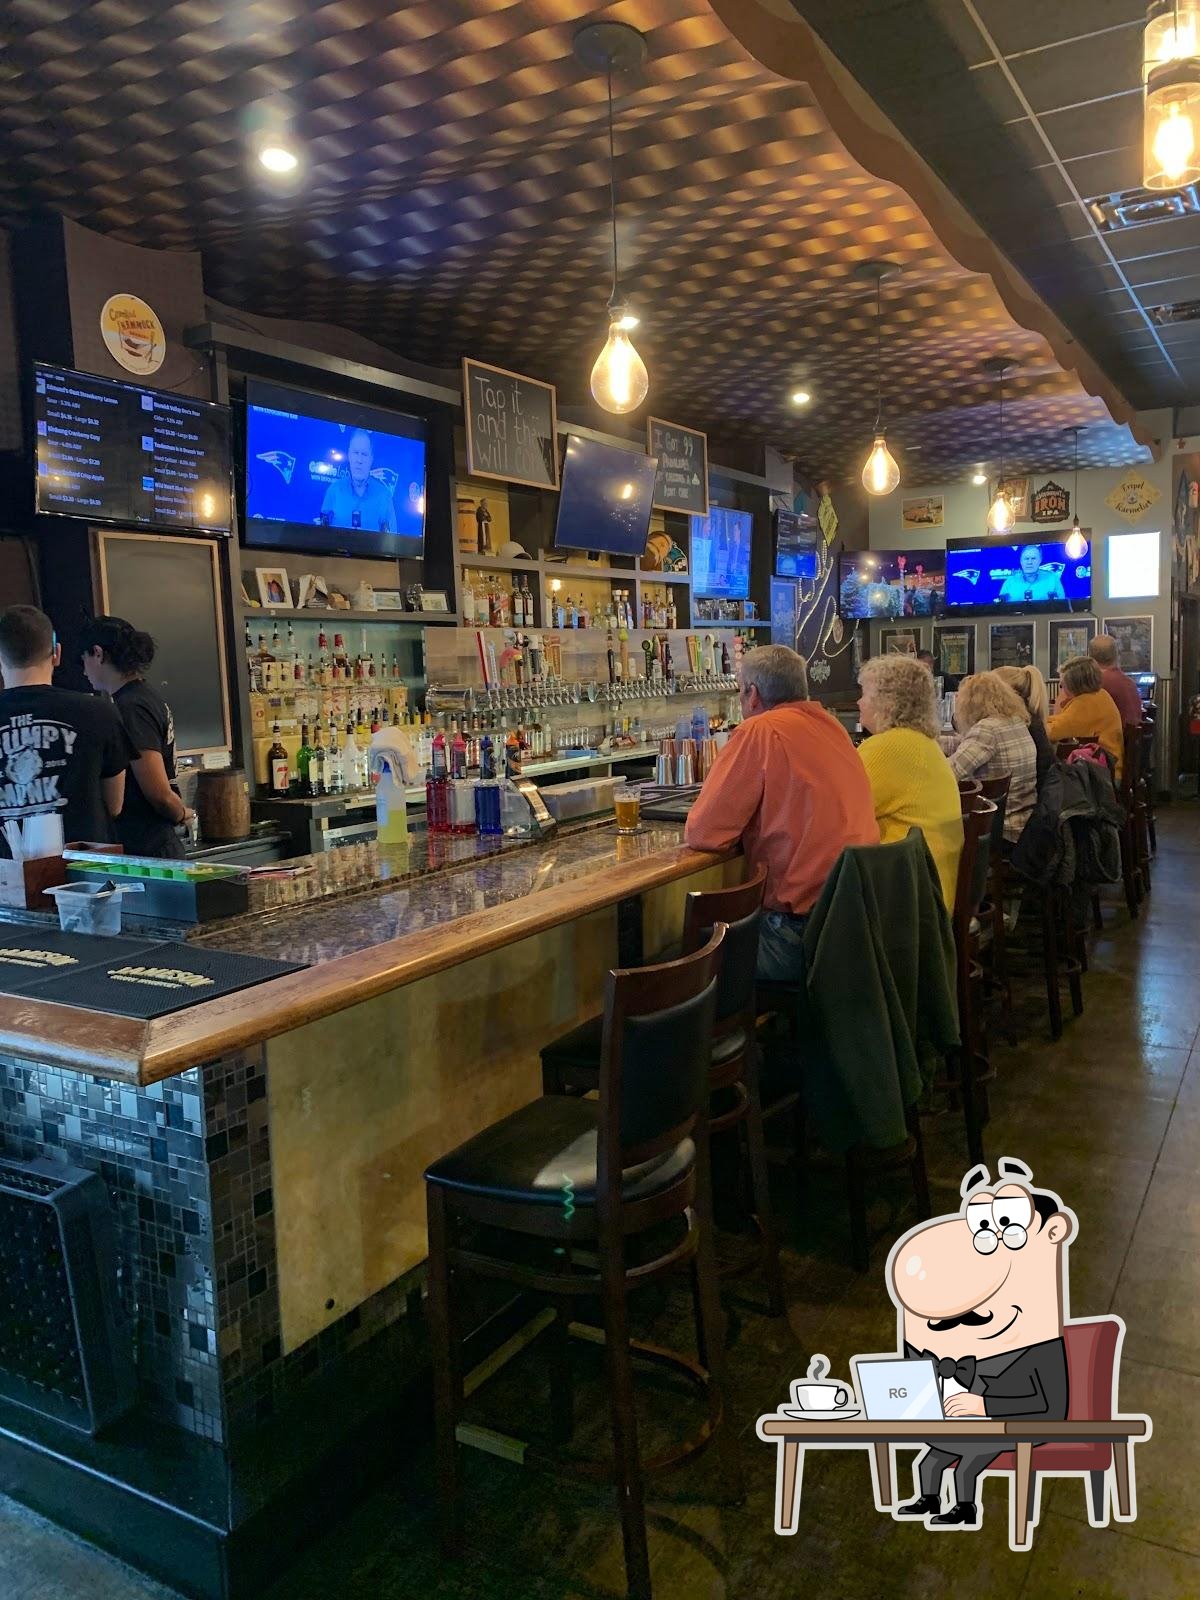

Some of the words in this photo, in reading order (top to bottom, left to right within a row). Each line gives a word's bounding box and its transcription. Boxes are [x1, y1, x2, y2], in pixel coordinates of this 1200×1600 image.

[475, 376, 506, 418] Tap
[511, 381, 522, 415] it
[477, 411, 506, 441] and
[475, 439, 509, 472] will
[1034, 494, 1066, 513] IRON
[10, 713, 33, 728] THE
